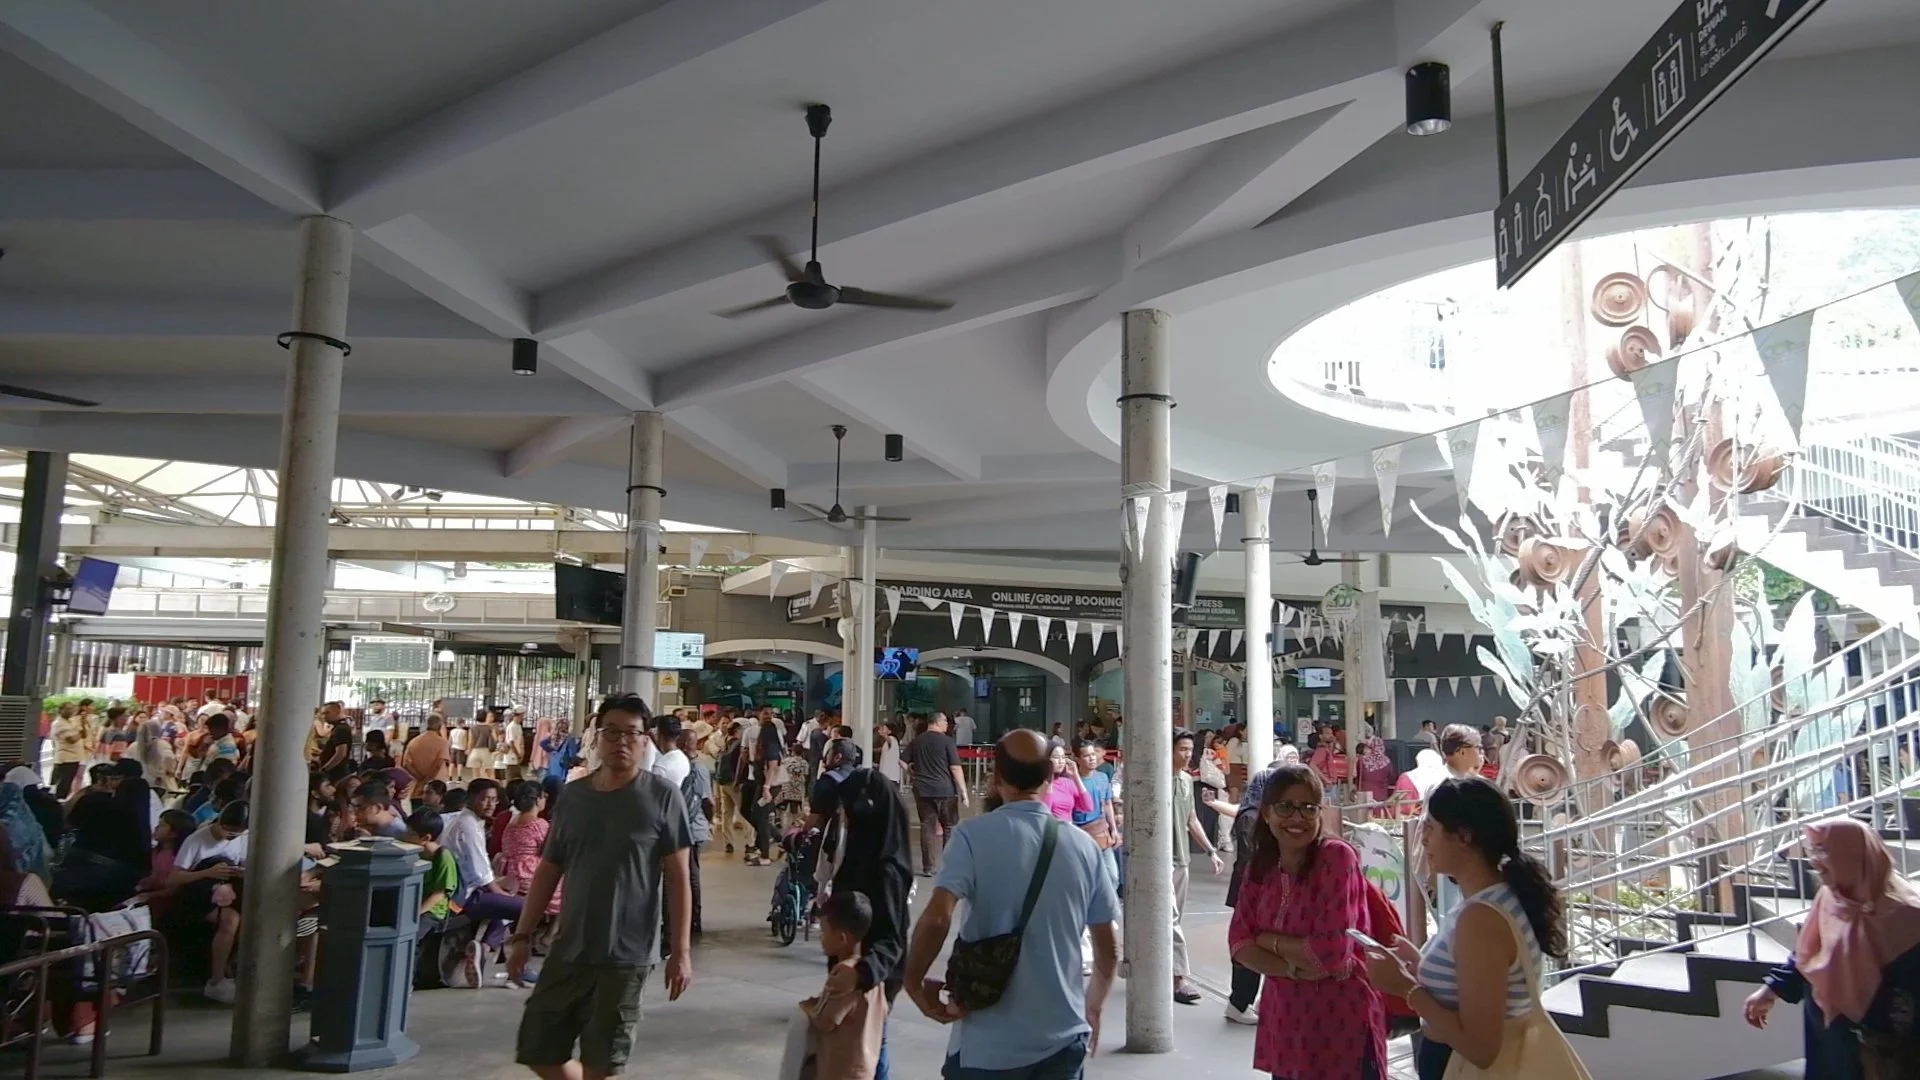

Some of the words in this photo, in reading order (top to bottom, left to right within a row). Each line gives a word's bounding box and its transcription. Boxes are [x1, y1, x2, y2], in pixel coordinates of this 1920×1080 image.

[1697, 5, 1728, 43] DEWAN
[943, 587, 973, 600] AREA
[991, 591, 1074, 605] ONLINE/GROUP
